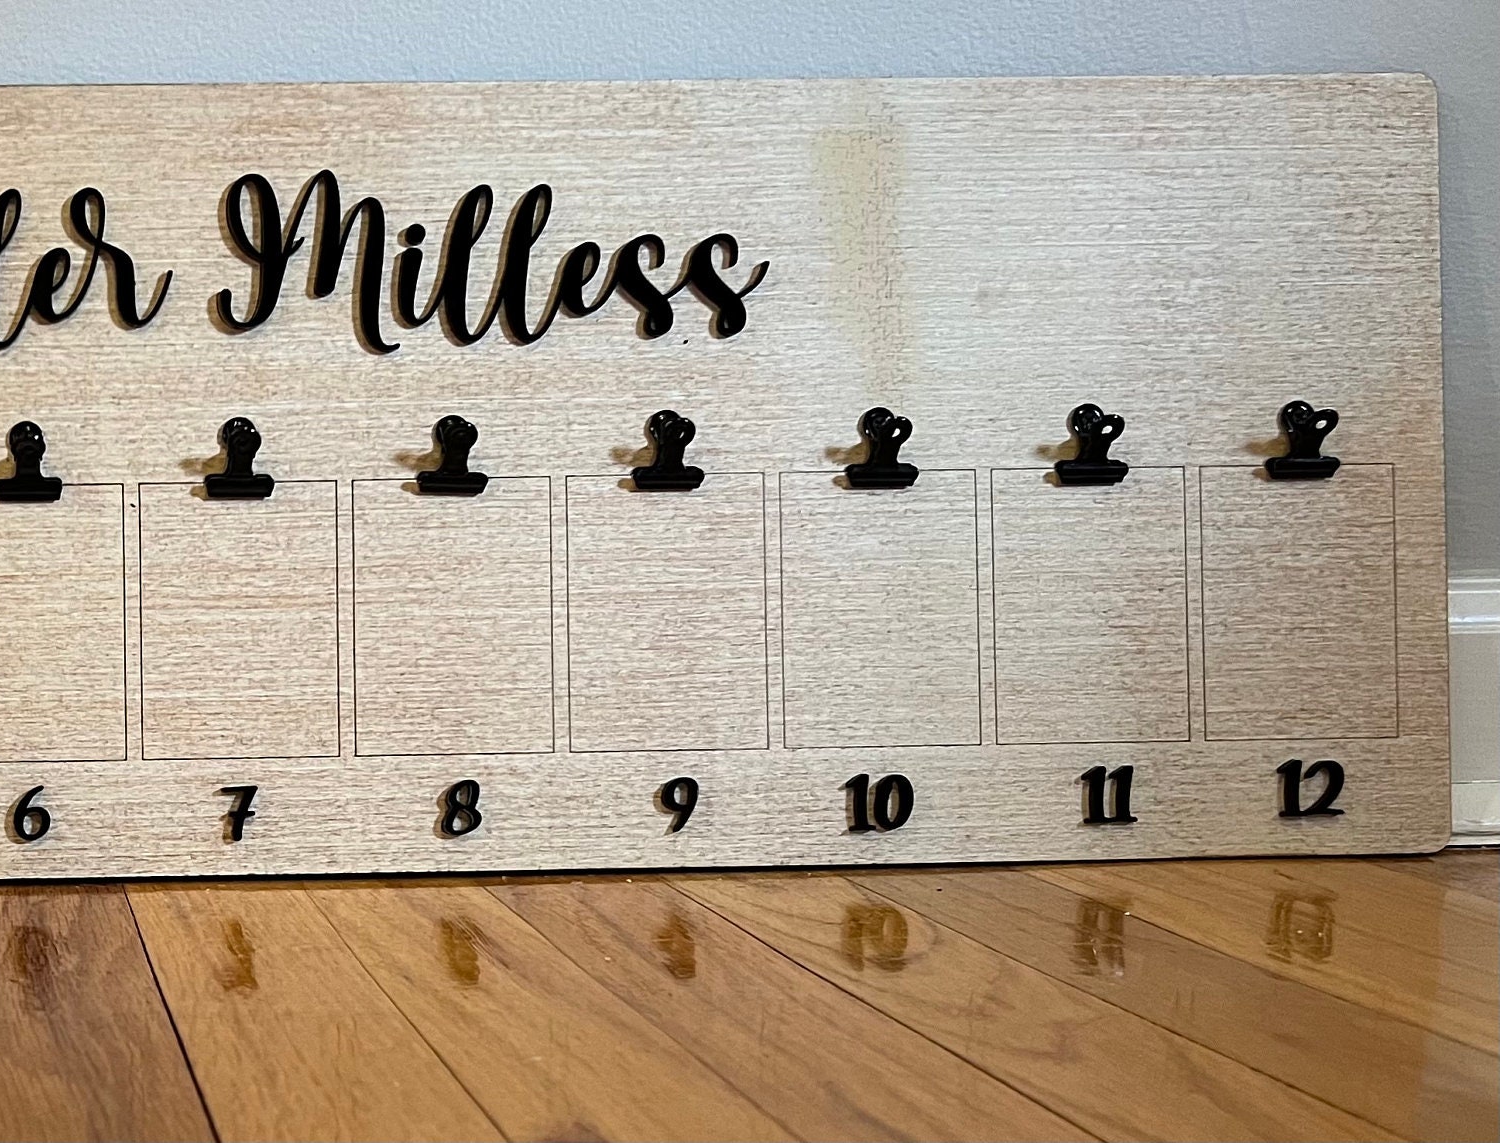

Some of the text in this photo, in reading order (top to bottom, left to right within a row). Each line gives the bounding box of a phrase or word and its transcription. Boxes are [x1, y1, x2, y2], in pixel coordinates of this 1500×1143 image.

[209, 168, 771, 356] Milless
[12, 785, 51, 843] 6
[218, 785, 259, 843] 7
[437, 779, 483, 838] 8
[656, 776, 699, 833] 9
[842, 773, 914, 834] 10
[1077, 764, 1139, 827] 11
[1273, 757, 1348, 821] 12
